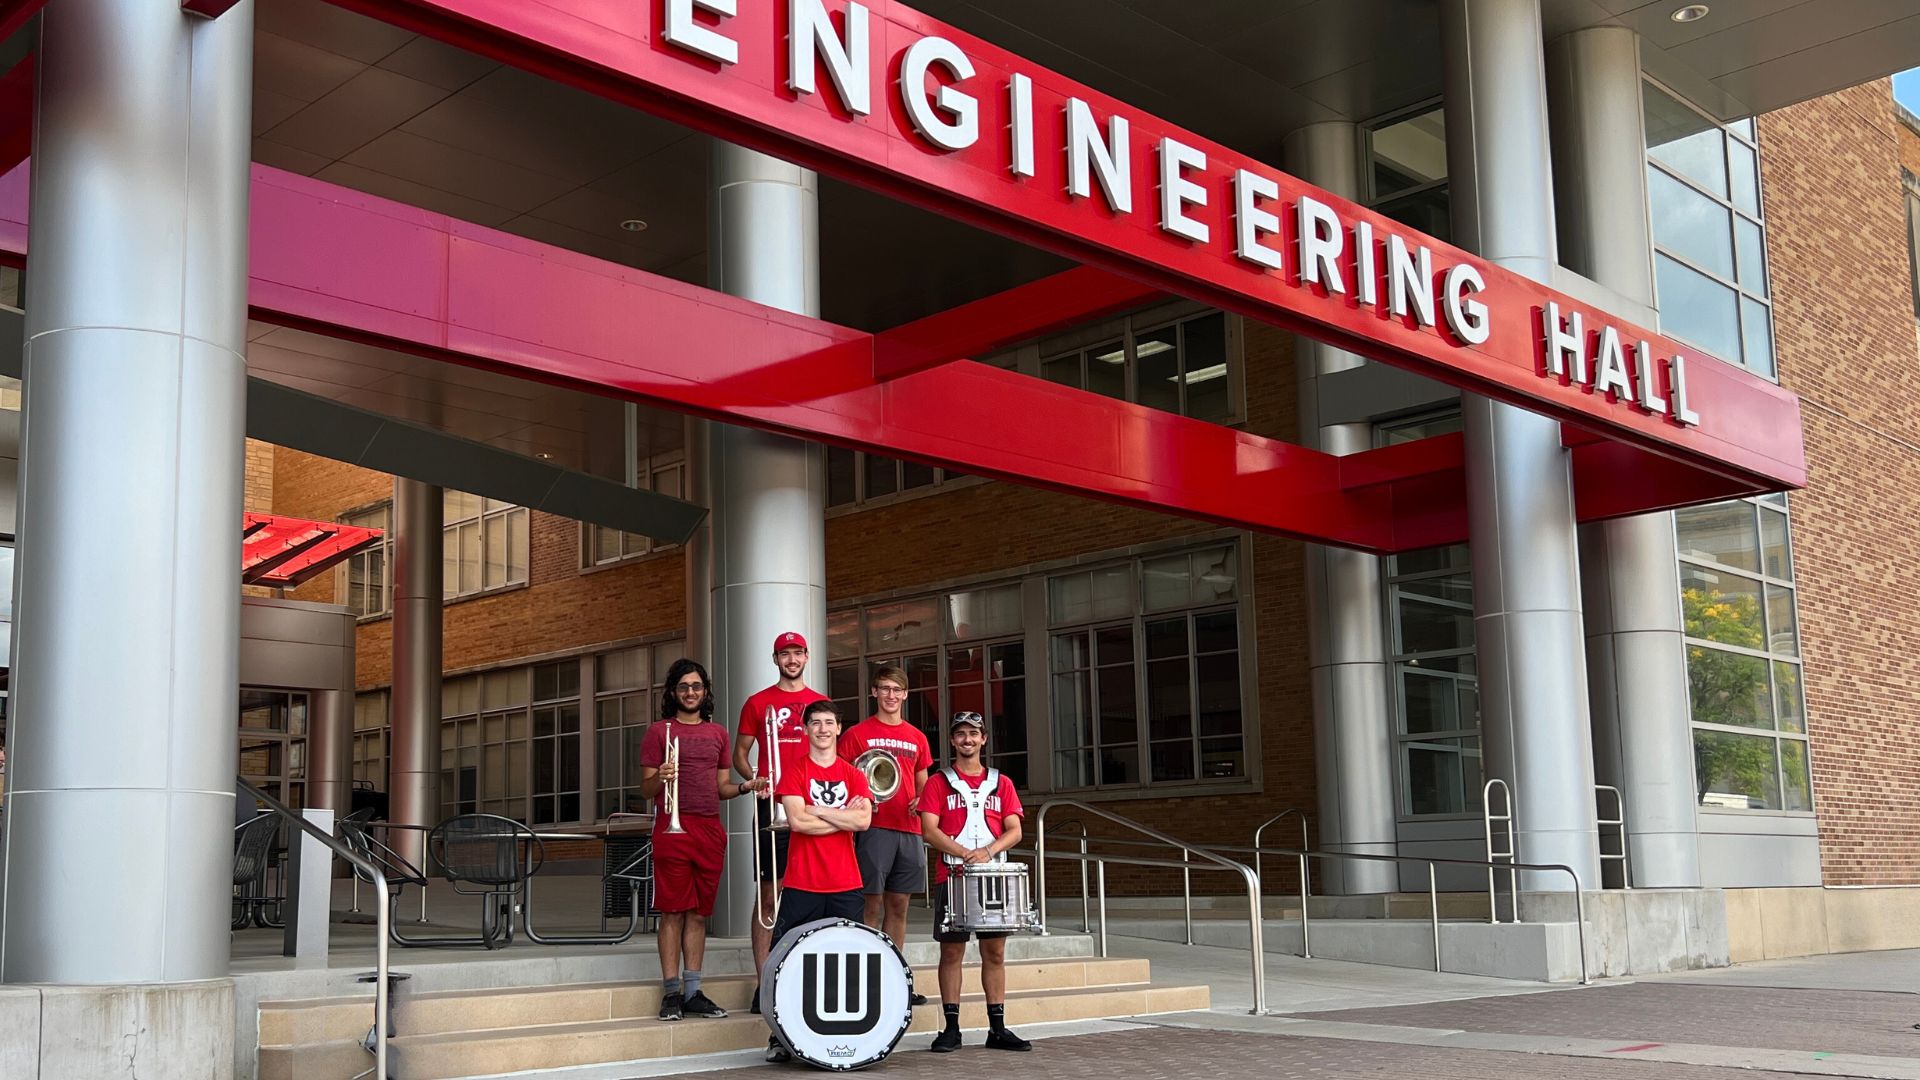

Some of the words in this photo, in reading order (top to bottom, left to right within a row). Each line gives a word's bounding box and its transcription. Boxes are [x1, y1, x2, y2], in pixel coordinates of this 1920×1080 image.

[1544, 301, 1700, 426] HALL
[866, 738, 917, 752] WISCONSIN
[947, 793, 1001, 813] WISSIN
